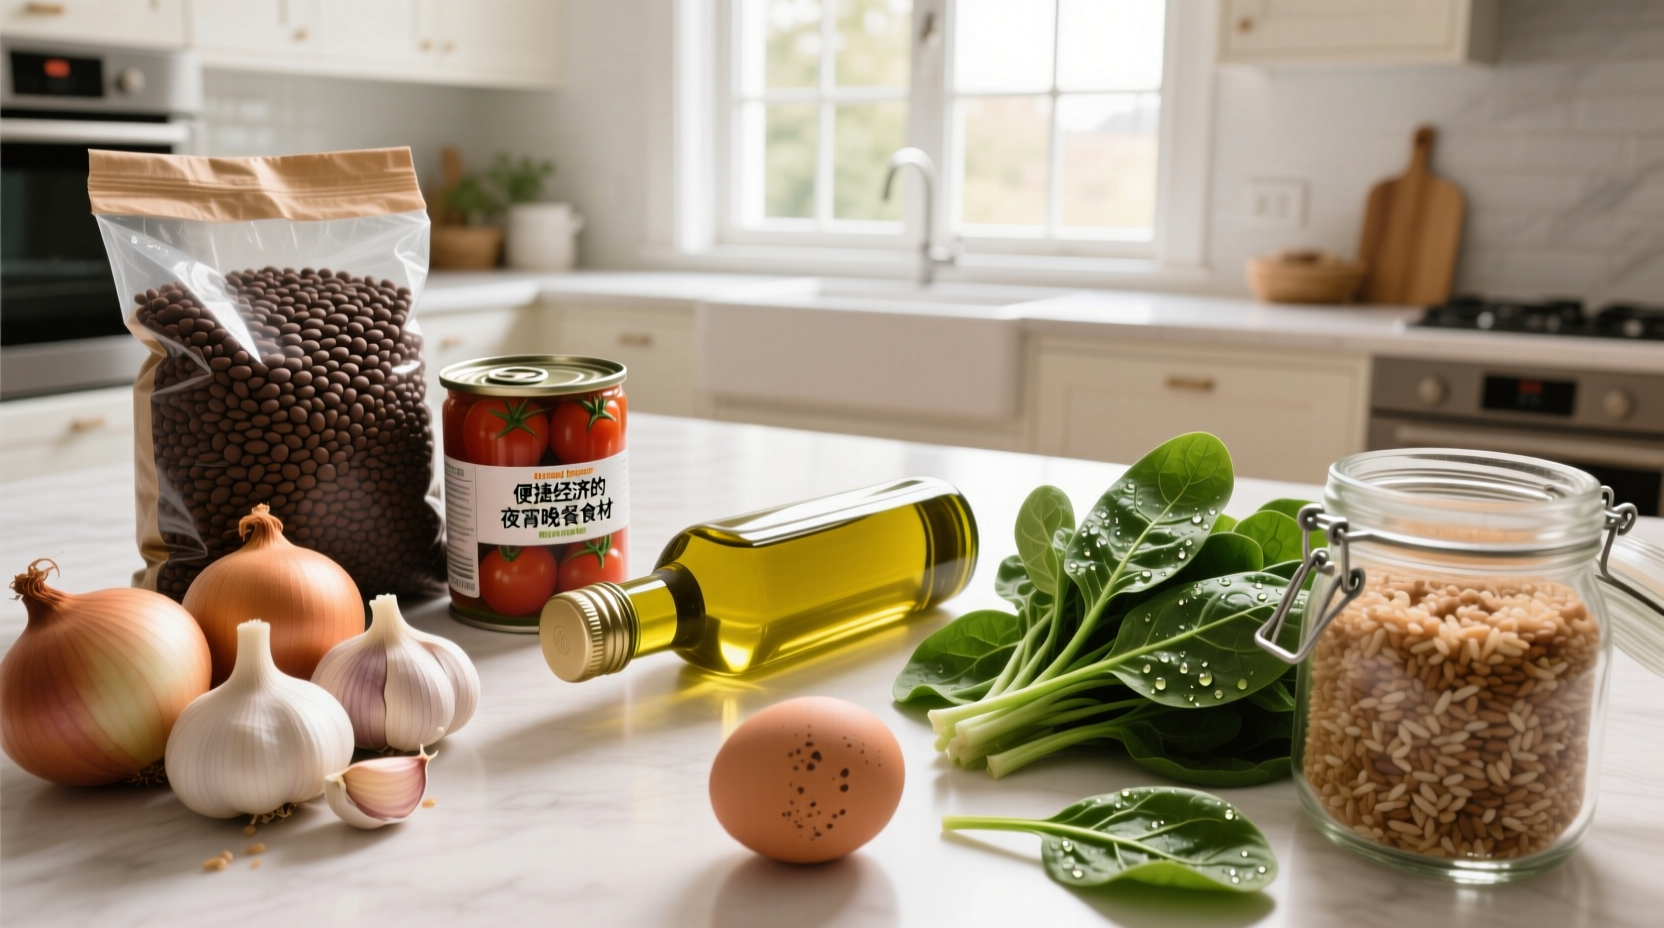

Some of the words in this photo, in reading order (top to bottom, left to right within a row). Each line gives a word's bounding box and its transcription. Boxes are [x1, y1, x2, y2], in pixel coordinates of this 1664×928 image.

[514, 477, 606, 504] 便捷经济的
[501, 497, 613, 529] 夜宵晚餐食材
